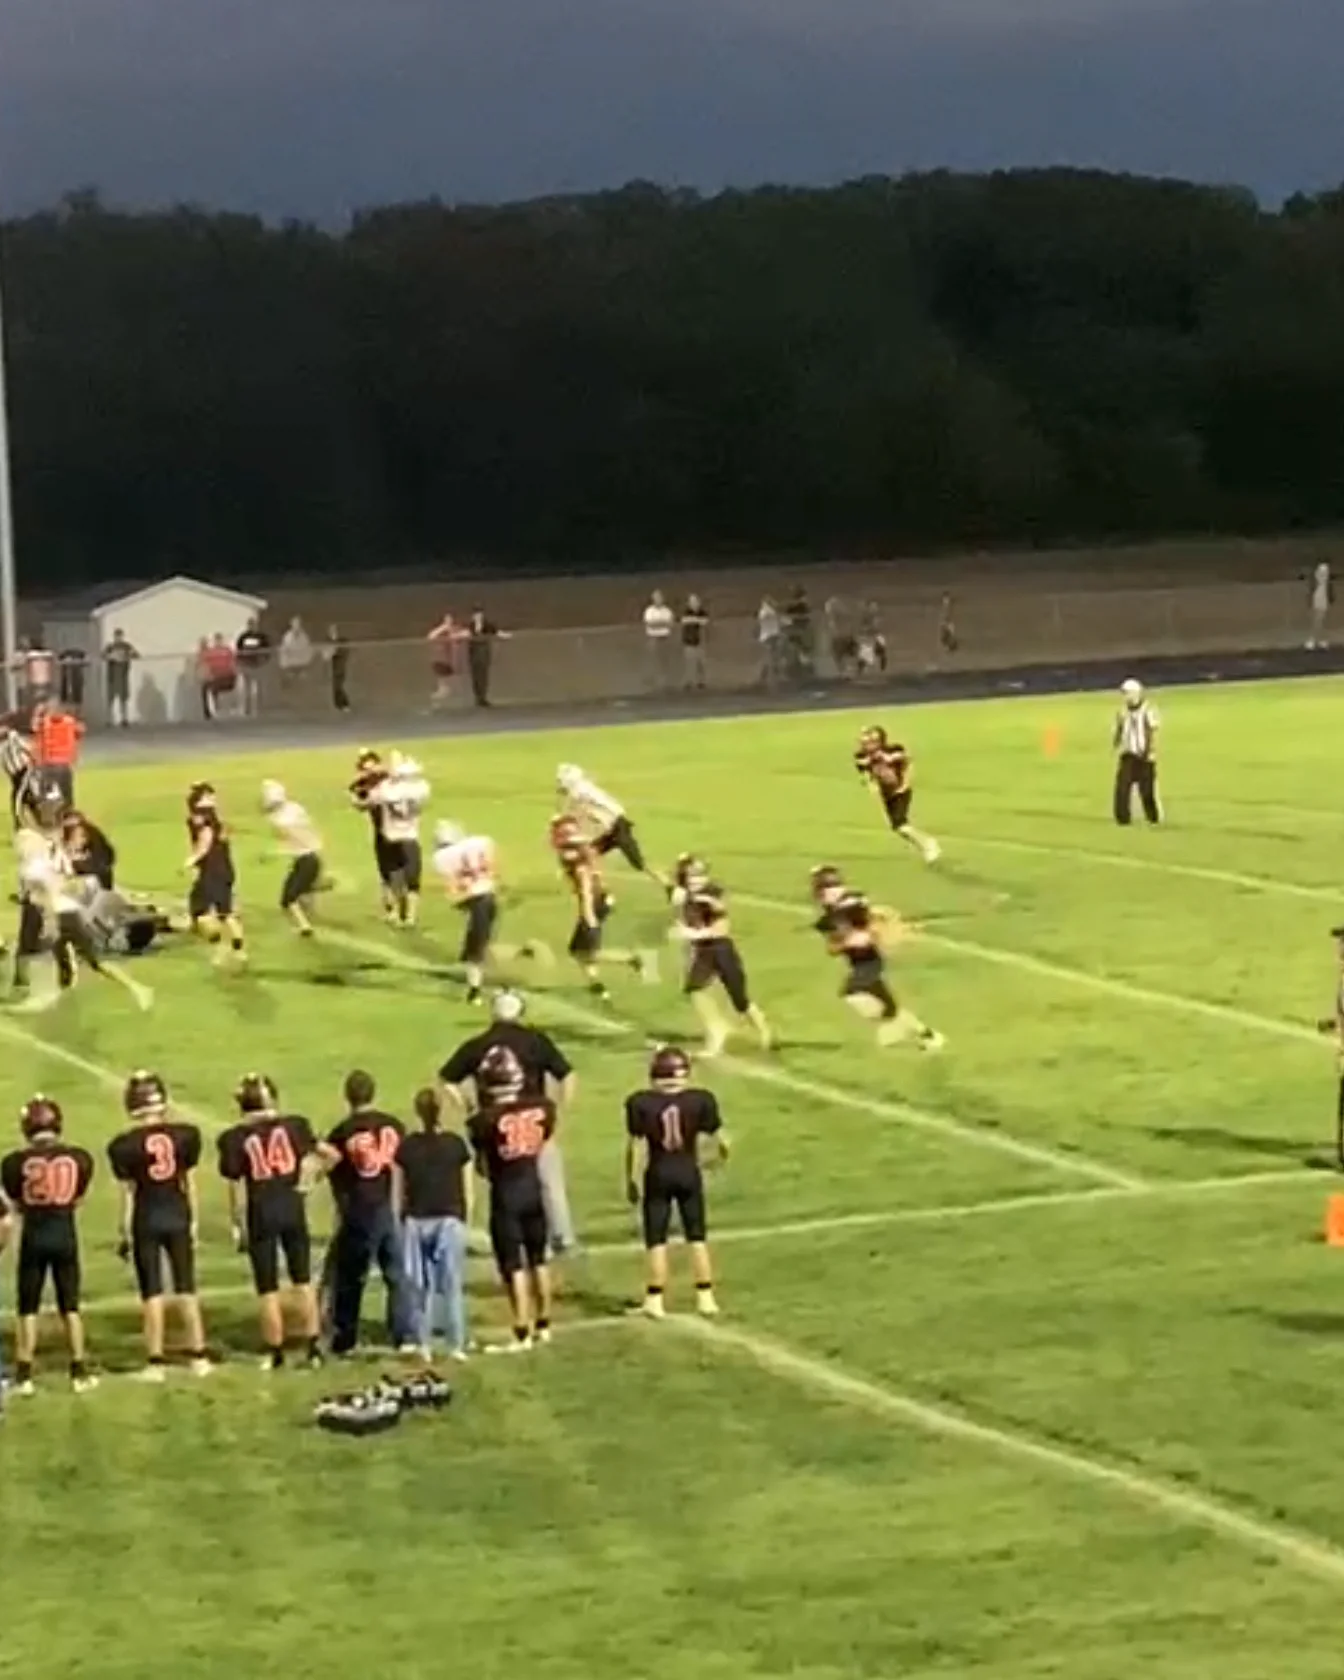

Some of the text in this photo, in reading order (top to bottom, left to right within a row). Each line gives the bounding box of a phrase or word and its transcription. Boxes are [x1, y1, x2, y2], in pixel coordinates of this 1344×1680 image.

[661, 1104, 683, 1151] 1
[145, 1133, 176, 1181] 3
[244, 1126, 297, 1181] 14
[23, 1155, 78, 1205] 20
